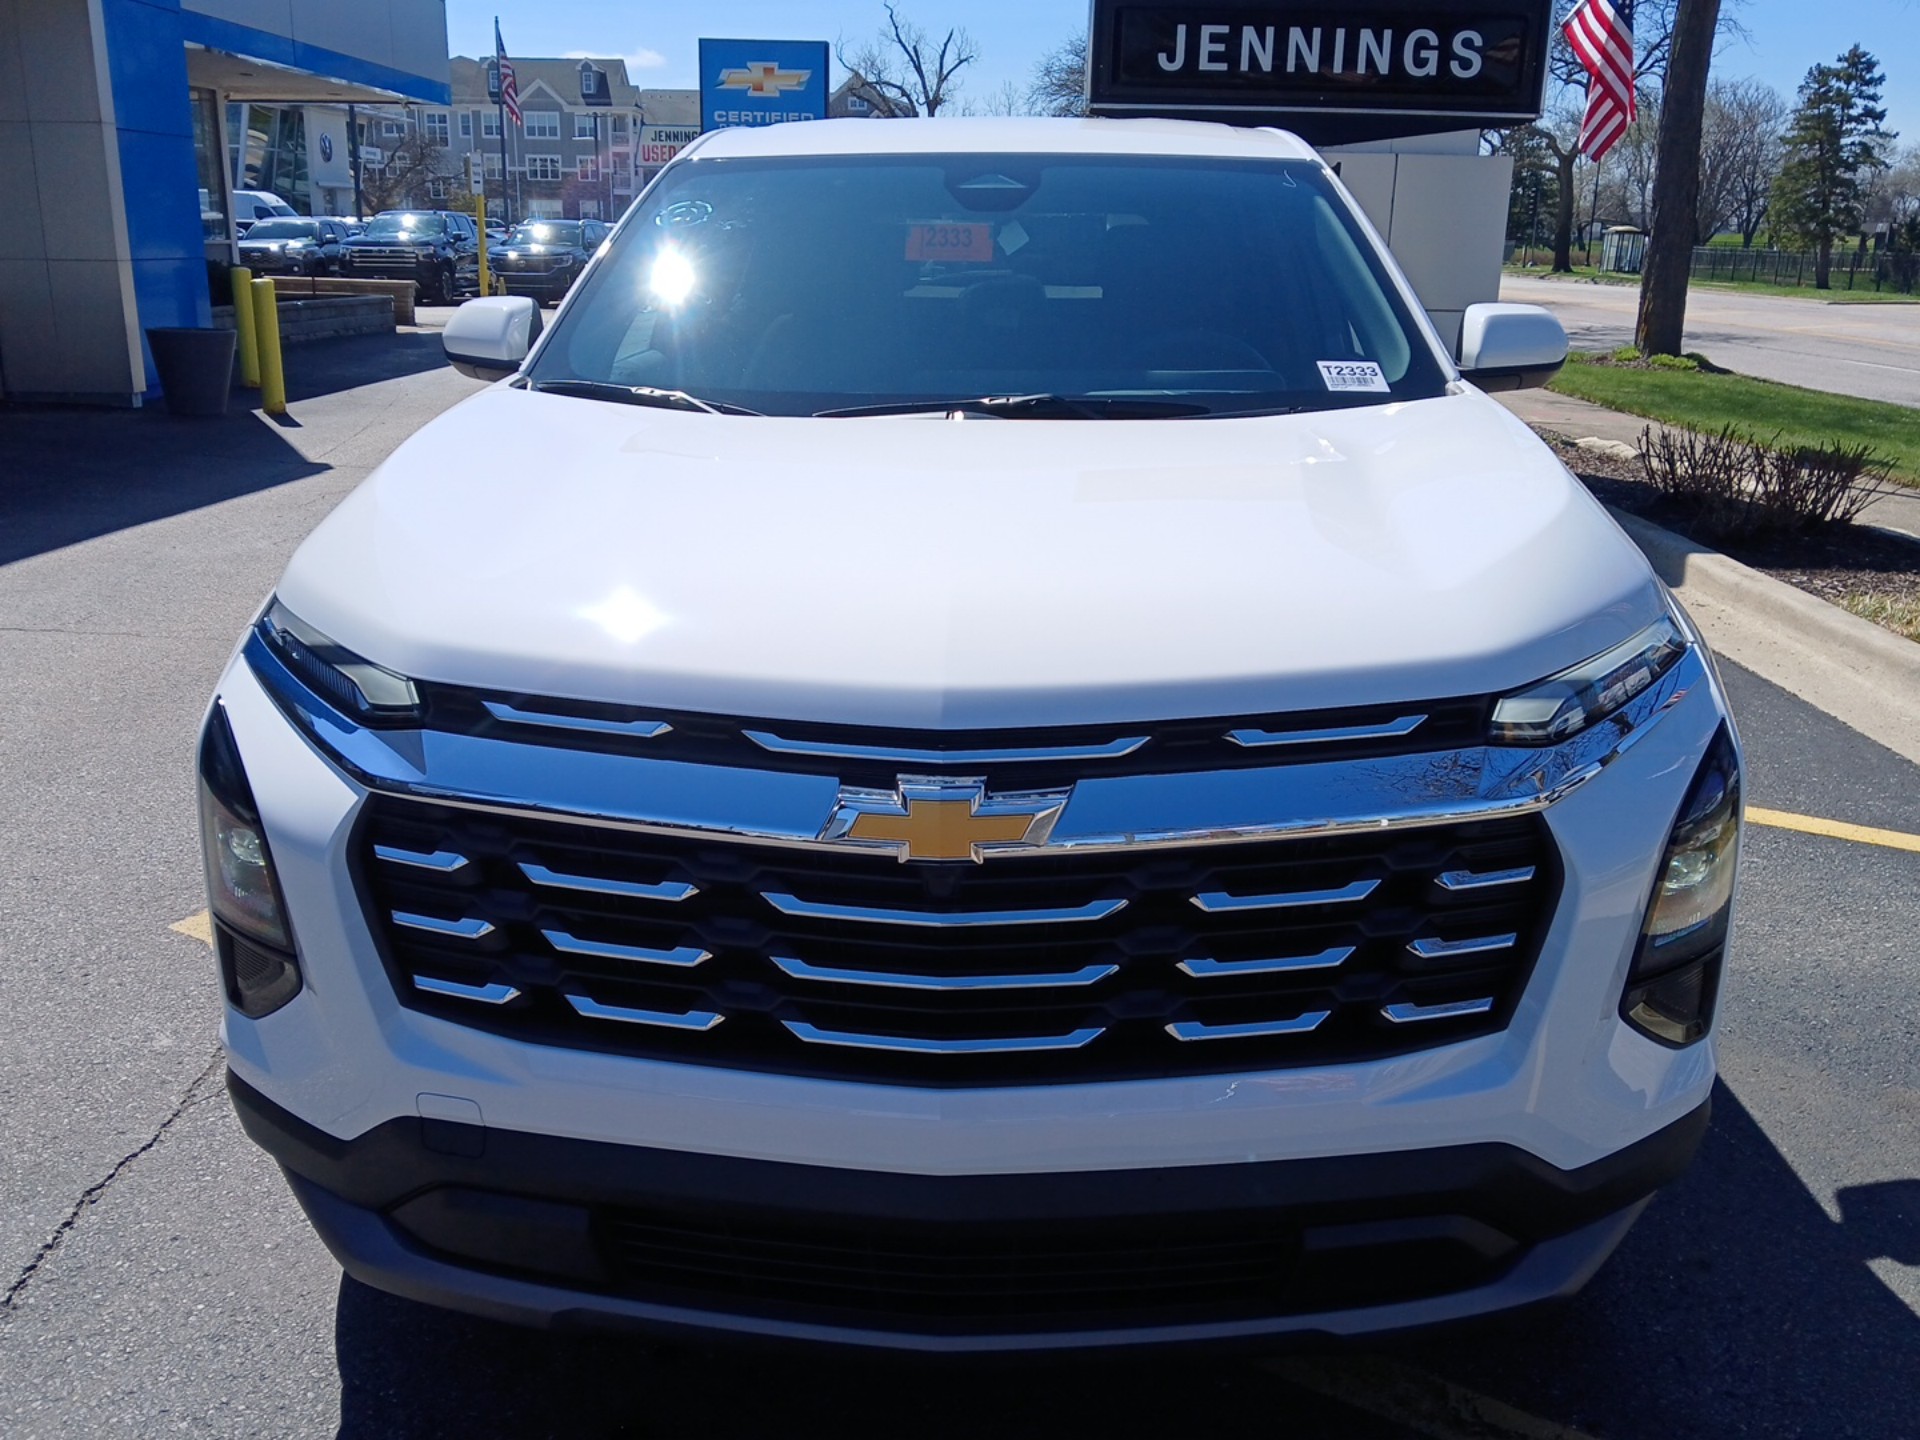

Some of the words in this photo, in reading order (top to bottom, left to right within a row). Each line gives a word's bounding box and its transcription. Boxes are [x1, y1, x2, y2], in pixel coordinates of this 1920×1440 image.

[1157, 23, 1484, 79] JENNINGS
[713, 110, 814, 123] CERTIFIED
[651, 130, 702, 142] JENNING
[642, 145, 676, 162] USED
[1322, 365, 1378, 377] T2333
